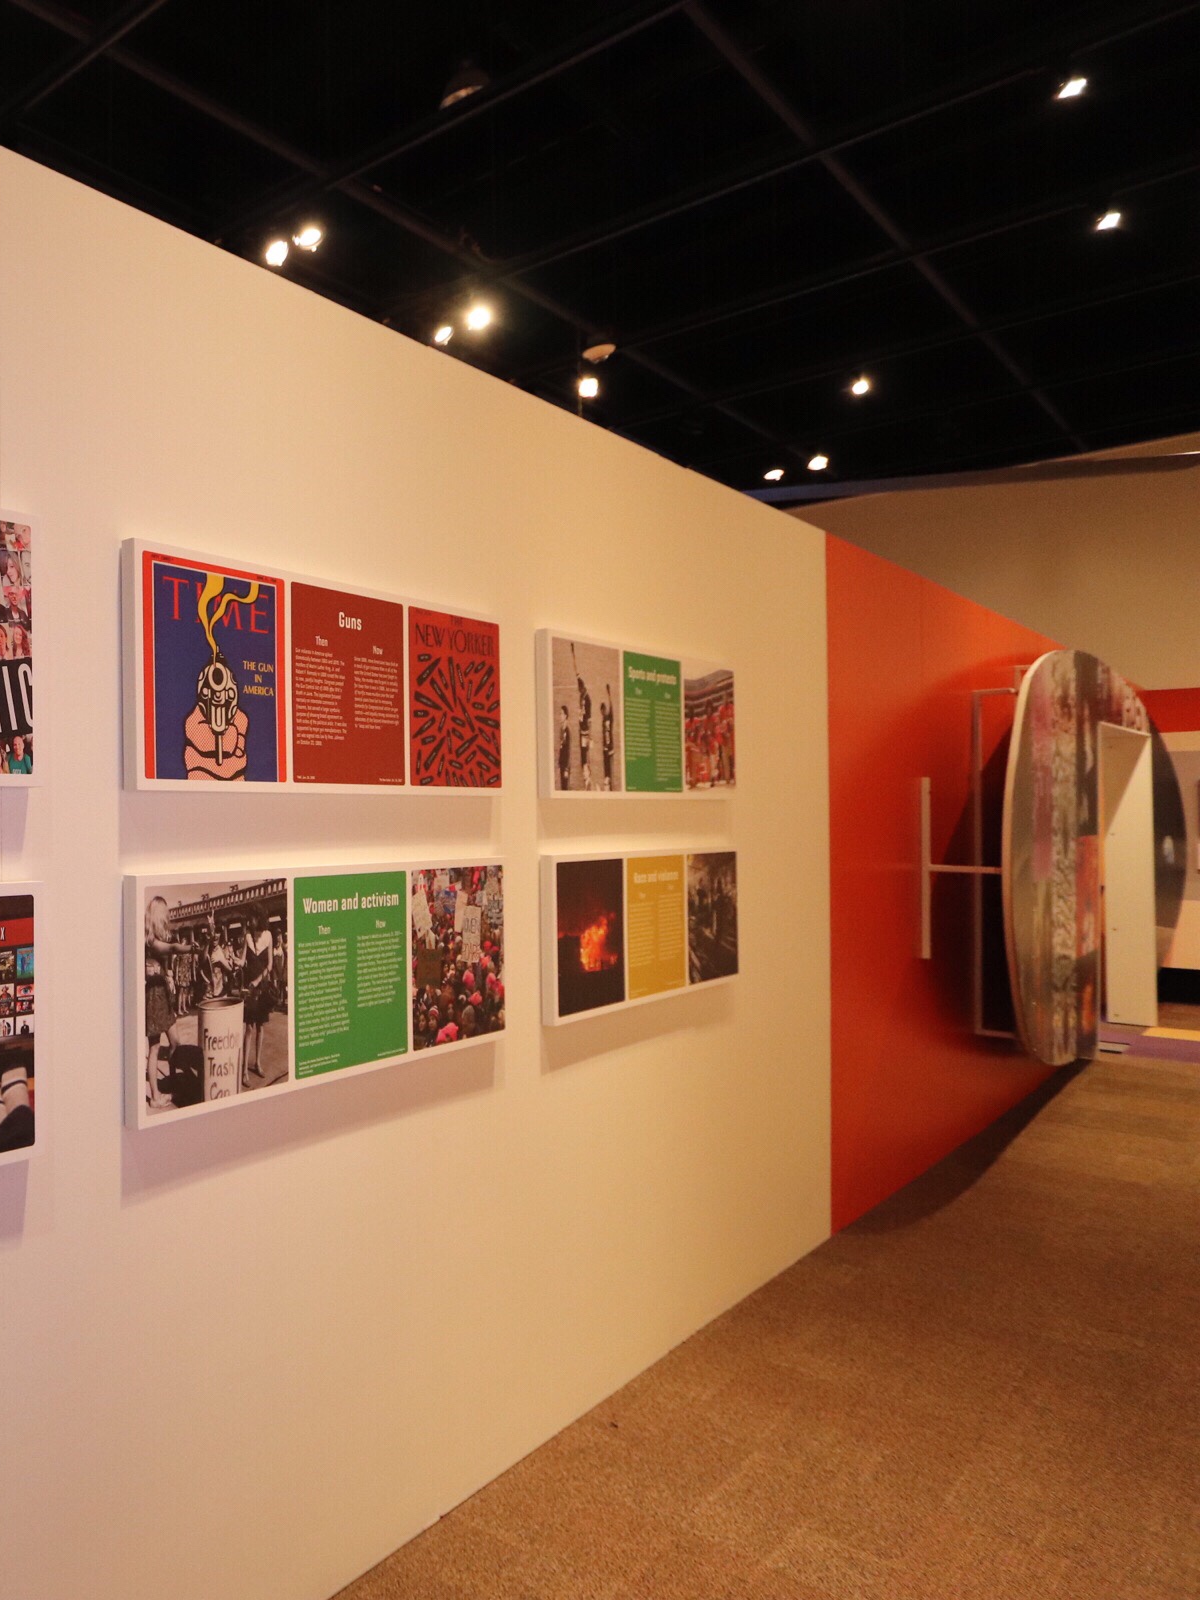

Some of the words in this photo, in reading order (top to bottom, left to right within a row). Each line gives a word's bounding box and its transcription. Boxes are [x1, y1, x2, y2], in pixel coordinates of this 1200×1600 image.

[338, 611, 362, 631] Guns
[315, 635, 328, 647] Then
[415, 623, 445, 648] NEW
[448, 629, 495, 656] YORKER
[243, 660, 256, 671] THE
[258, 662, 274, 673] GUN
[255, 674, 262, 683] IN
[243, 685, 274, 697] AMERICA
[302, 897, 339, 914] Women
[341, 893, 358, 911] and
[361, 893, 400, 908] activism
[208, 1056, 235, 1078] Trash
